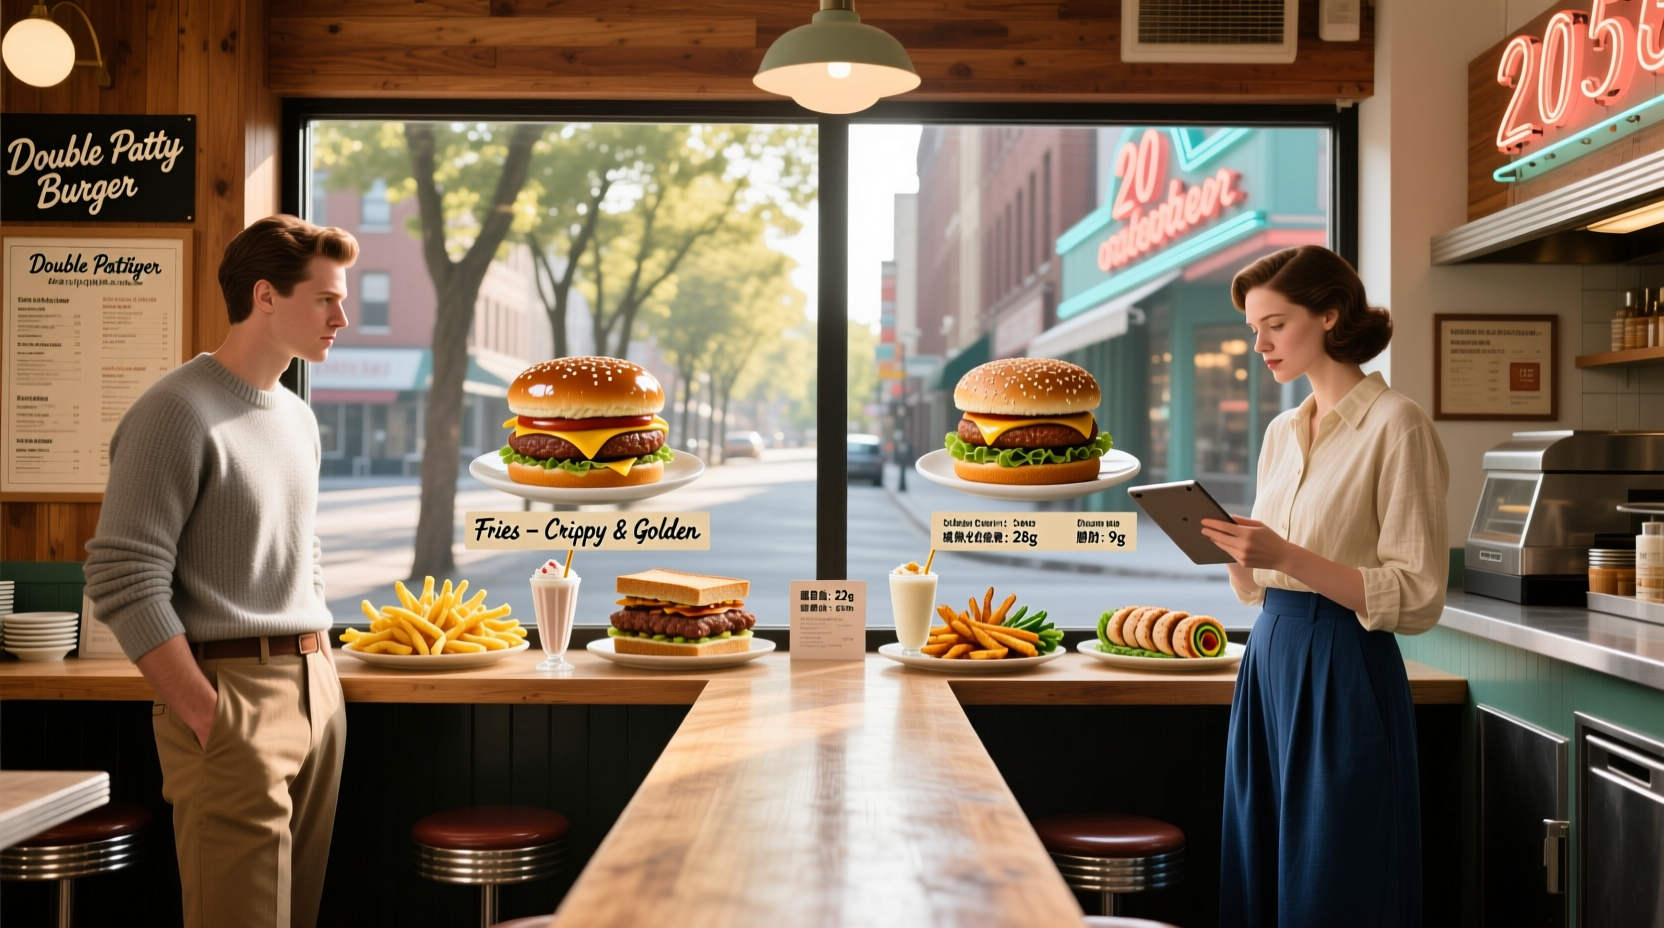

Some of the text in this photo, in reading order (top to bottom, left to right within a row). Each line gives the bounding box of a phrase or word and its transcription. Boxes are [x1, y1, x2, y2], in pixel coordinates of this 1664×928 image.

[7, 129, 184, 176] Double Patty
[1112, 128, 1168, 220] 20
[37, 172, 138, 215] Burger
[29, 253, 88, 274] Double
[475, 517, 520, 541] Fries
[544, 517, 607, 547] Crippy
[613, 519, 627, 540] &
[633, 516, 701, 544] Golden
[1012, 530, 1038, 547] 28g
[1108, 530, 1126, 547] 9g
[835, 589, 854, 602] 22g
